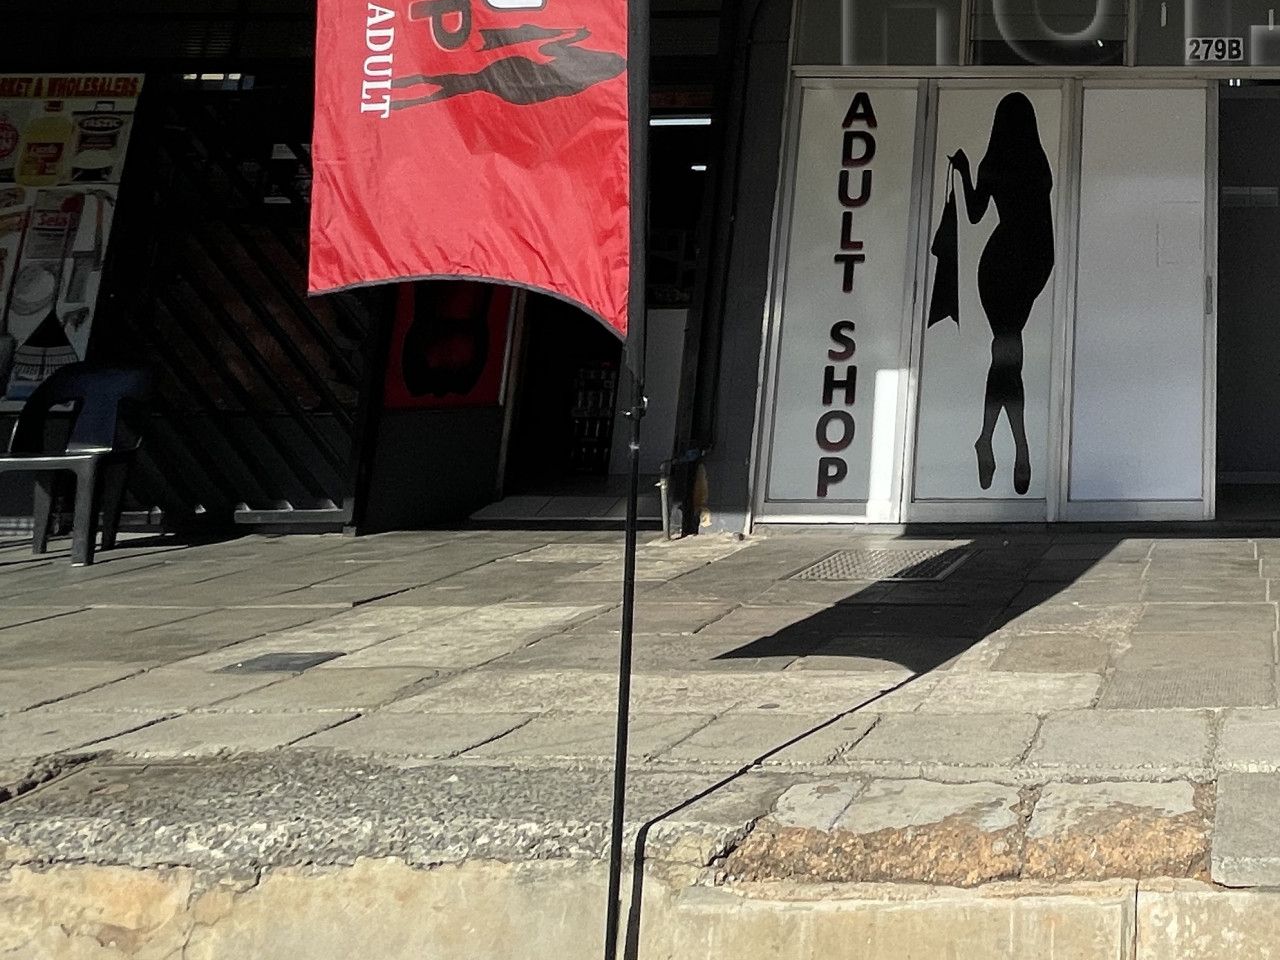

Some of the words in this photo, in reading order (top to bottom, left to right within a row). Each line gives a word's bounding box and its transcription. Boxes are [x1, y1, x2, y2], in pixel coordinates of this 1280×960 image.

[360, 3, 396, 119] ADULT
[1188, 39, 1242, 60] 279B
[834, 91, 879, 294] ADULT
[814, 319, 858, 498] SHOP
